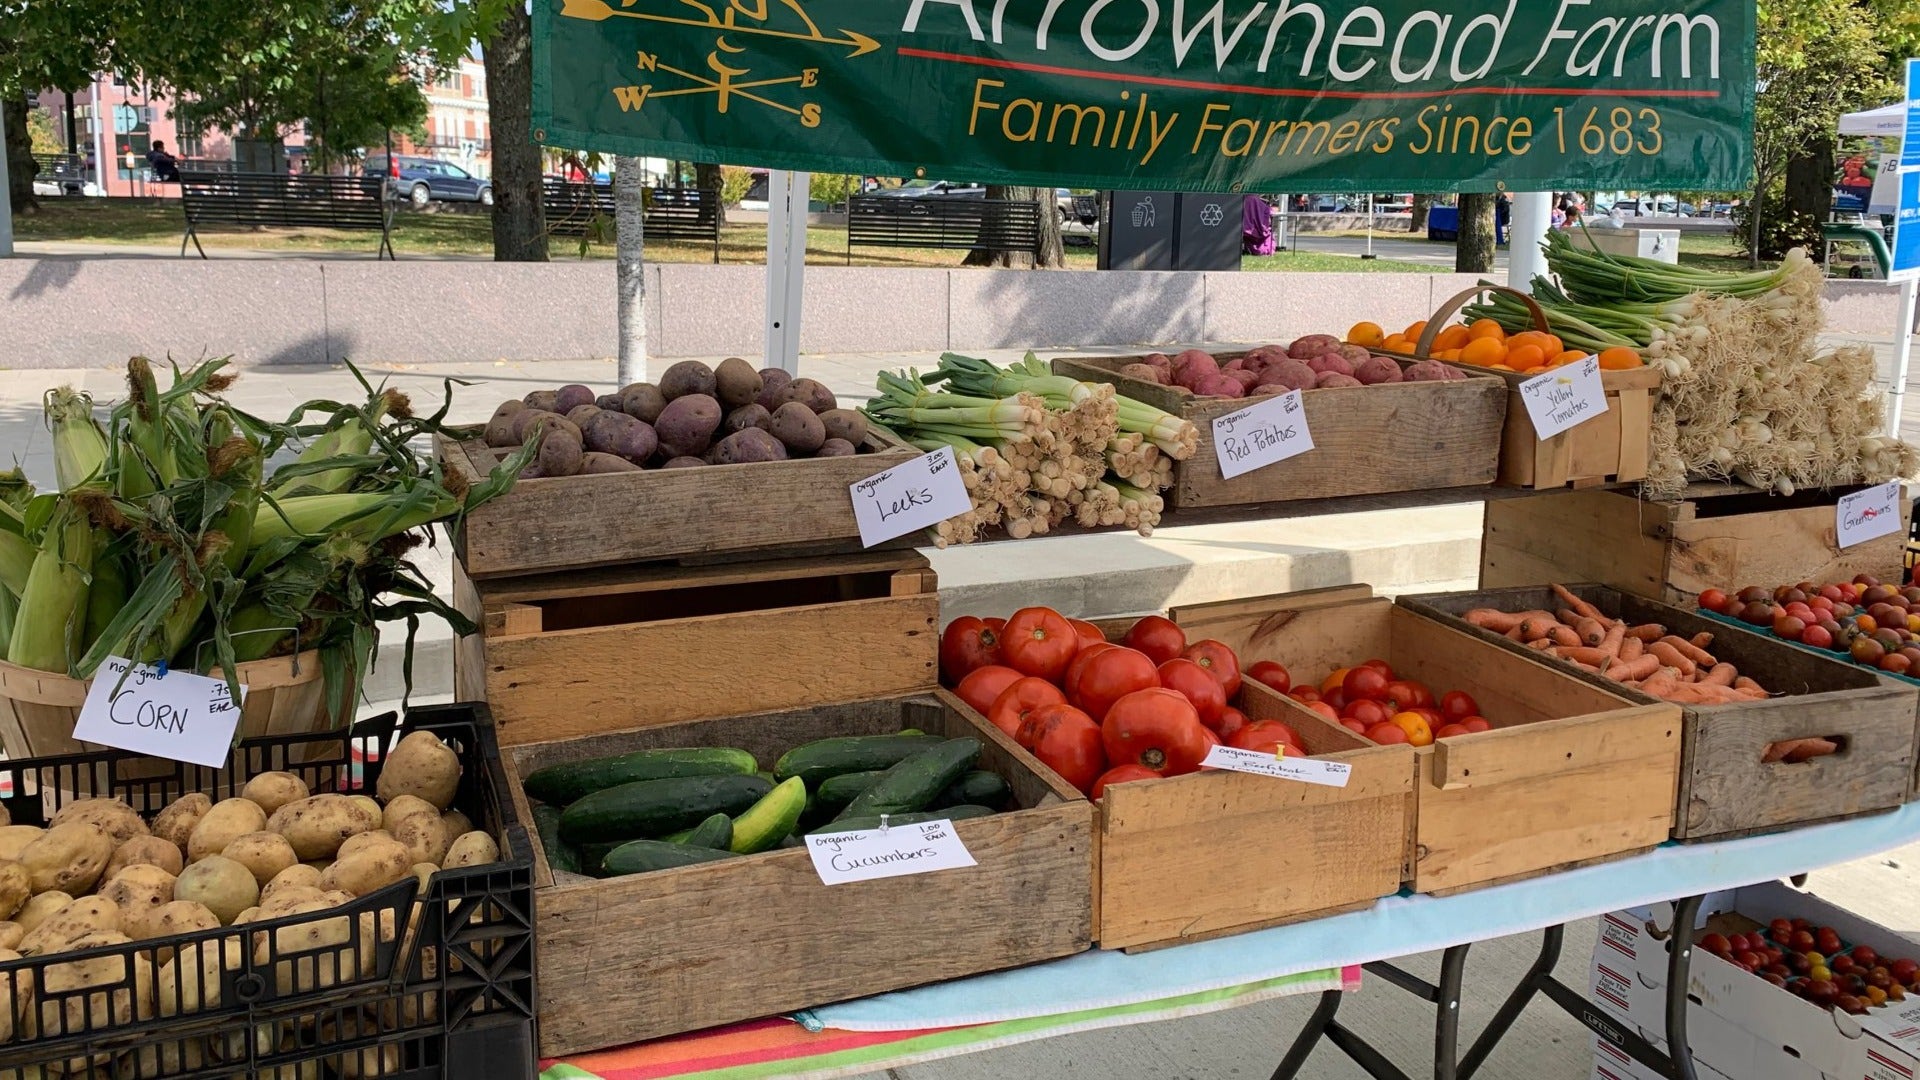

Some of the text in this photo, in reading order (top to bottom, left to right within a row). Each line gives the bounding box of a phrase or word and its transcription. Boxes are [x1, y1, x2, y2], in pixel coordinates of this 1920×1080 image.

[1521, 0, 1720, 79] Farm
[637, 51, 657, 72] N
[801, 69, 819, 88] E
[613, 86, 651, 111] W
[801, 103, 821, 128] S
[968, 78, 1663, 166] Family Farmers Since 1683
[1547, 385, 1574, 408] Yellow
[1217, 411, 1252, 433] organic
[1545, 399, 1589, 425] Tomatoes
[1224, 425, 1297, 462] Red Potatoes
[856, 473, 893, 497] organic
[876, 488, 933, 521] Leeks
[109, 661, 164, 685] no-gmo
[109, 690, 188, 734] CORN
[1219, 748, 1265, 759] organic
[919, 823, 940, 833] 1.00
[816, 833, 867, 851] organic
[832, 848, 937, 871] Cucumbers
